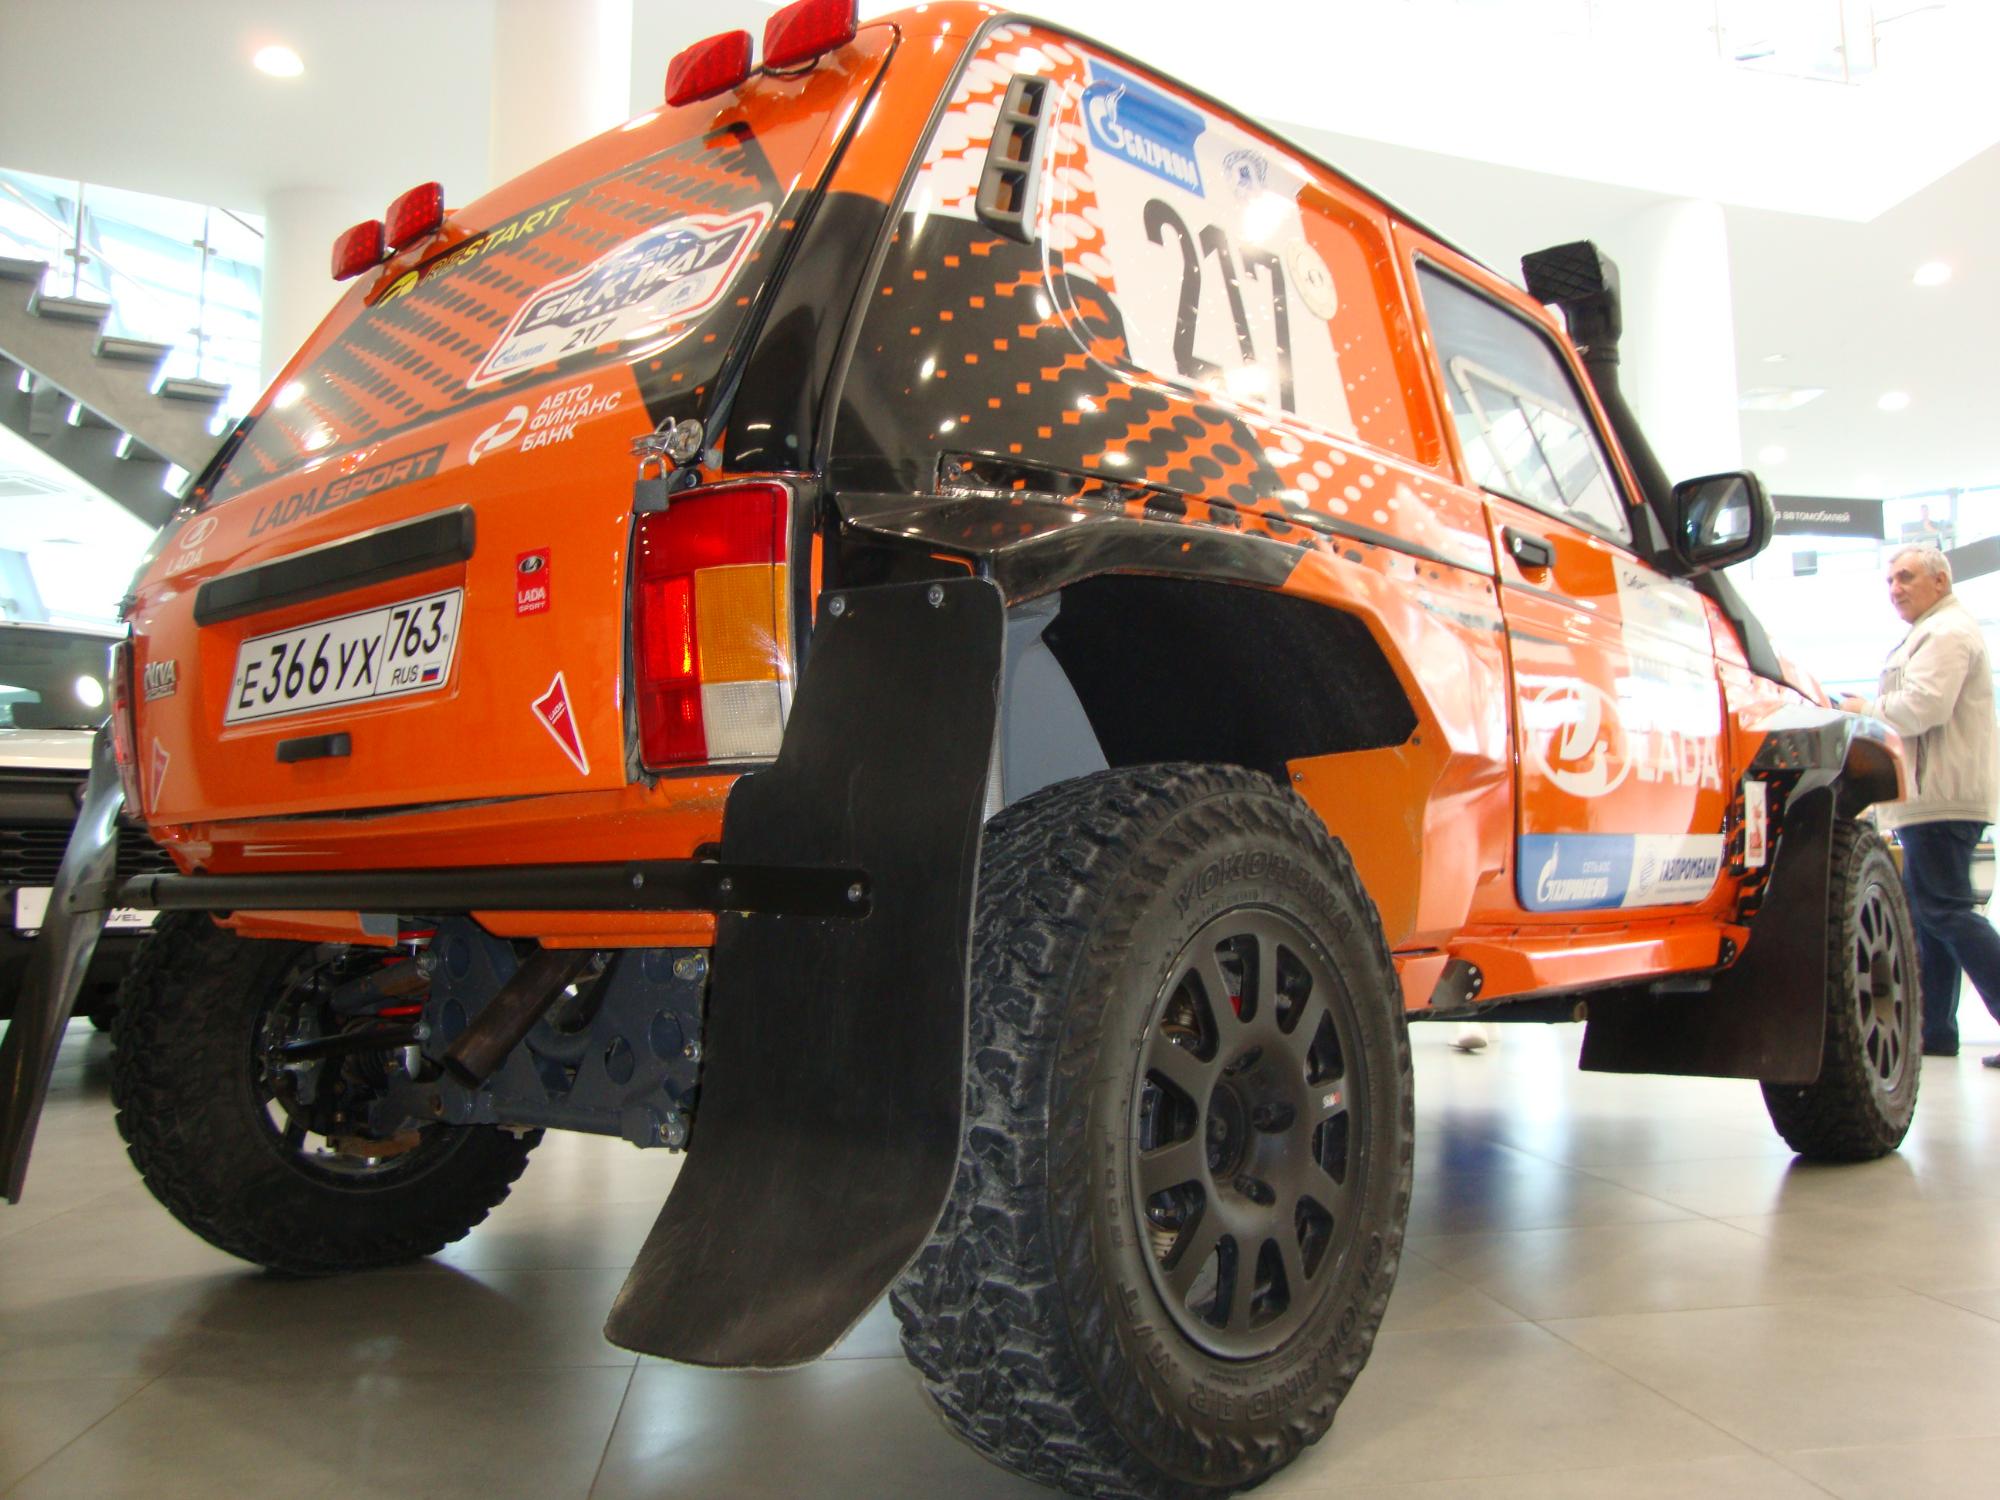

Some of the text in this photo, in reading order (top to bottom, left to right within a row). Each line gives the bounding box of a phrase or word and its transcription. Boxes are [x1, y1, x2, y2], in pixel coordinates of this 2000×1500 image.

[1123, 129, 1199, 187] GAZPROM
[525, 269, 634, 329] SILK
[627, 232, 736, 293] WAY
[1143, 198, 1295, 414] 217
[559, 317, 617, 352] 217
[529, 391, 622, 430] ФИНАНС
[536, 383, 593, 413] АВТО
[520, 421, 578, 452] БАНК
[248, 452, 435, 537] LADA SPORT
[165, 546, 205, 576] LADA
[518, 586, 546, 604] LADA
[518, 600, 546, 613] SPORT
[389, 600, 447, 662] 763
[392, 665, 419, 686] RUS
[1634, 727, 1722, 791] LADA
[1173, 850, 1353, 943] YOKOHAMA
